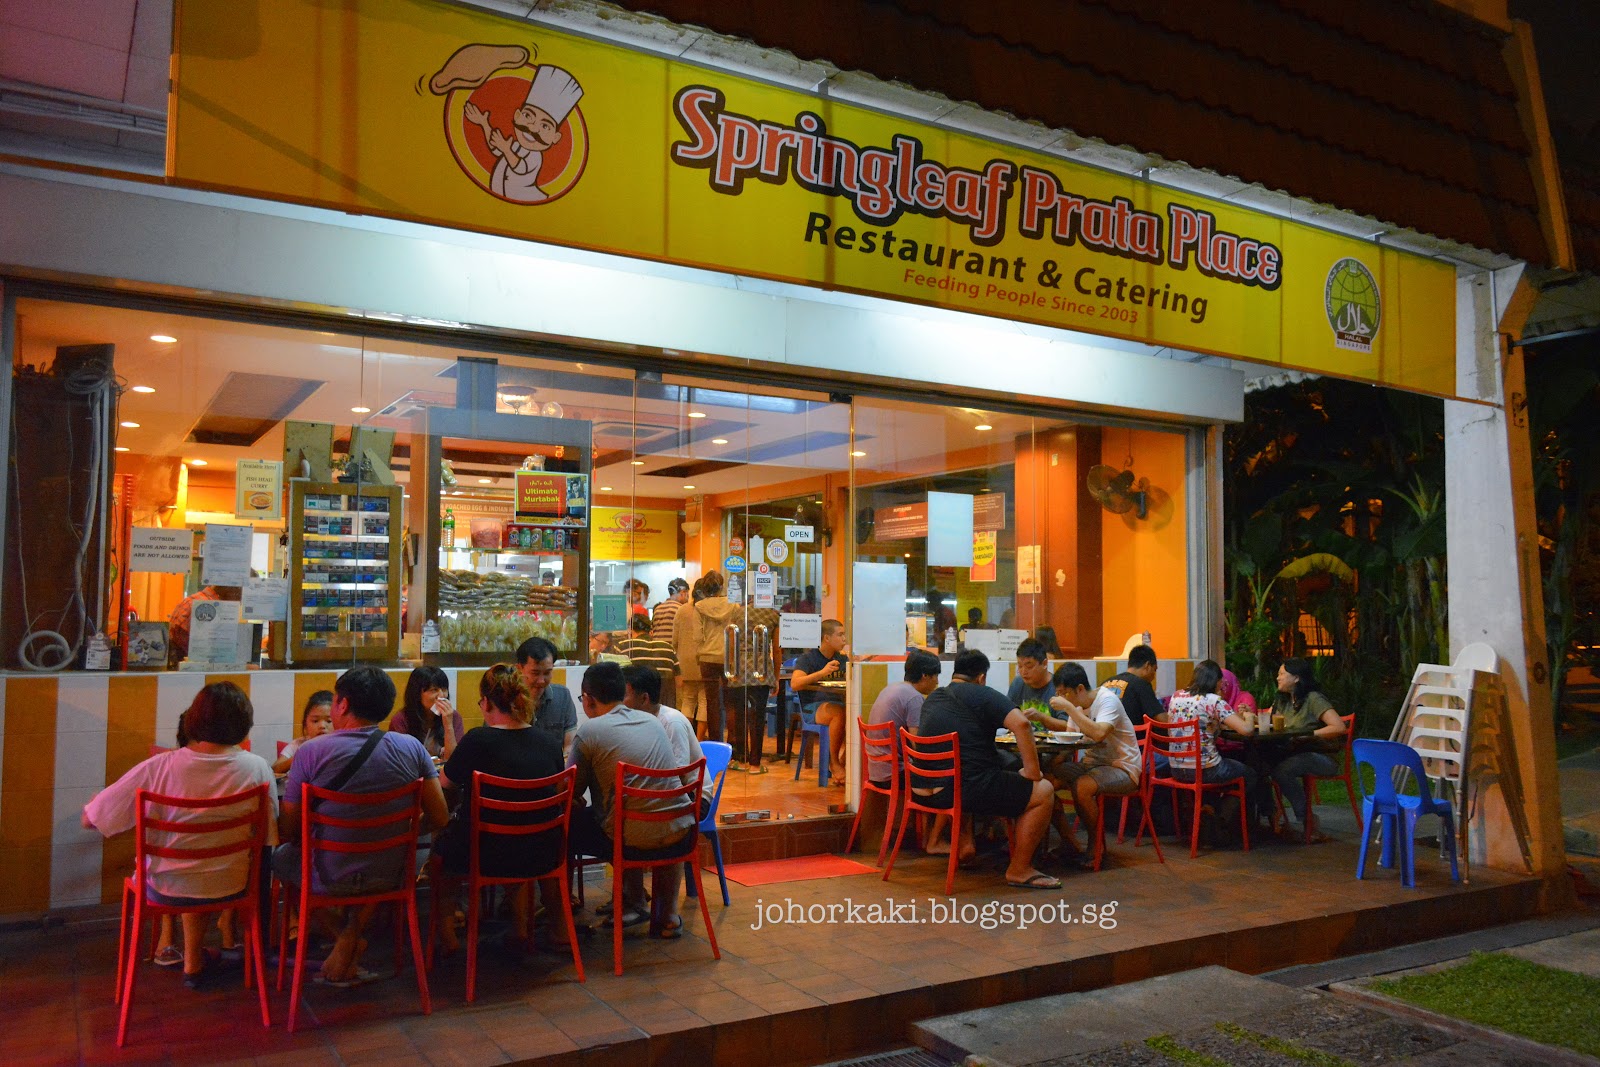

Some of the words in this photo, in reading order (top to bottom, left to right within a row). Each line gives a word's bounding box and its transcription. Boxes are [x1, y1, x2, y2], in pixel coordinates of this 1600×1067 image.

[674, 86, 1014, 242] Springleaf
[1021, 166, 1161, 261] Prata
[1168, 203, 1280, 287] Place
[804, 212, 1027, 283] Restaurant
[1037, 259, 1063, 289] &
[1074, 267, 1208, 324] Catering
[903, 269, 980, 299] Feeding
[985, 283, 1047, 307] People
[1051, 295, 1096, 316] Since
[1100, 305, 1138, 323] 2003
[1344, 333, 1363, 342] HALAL
[789, 530, 809, 538] OPEN
[605, 605, 616, 622] B
